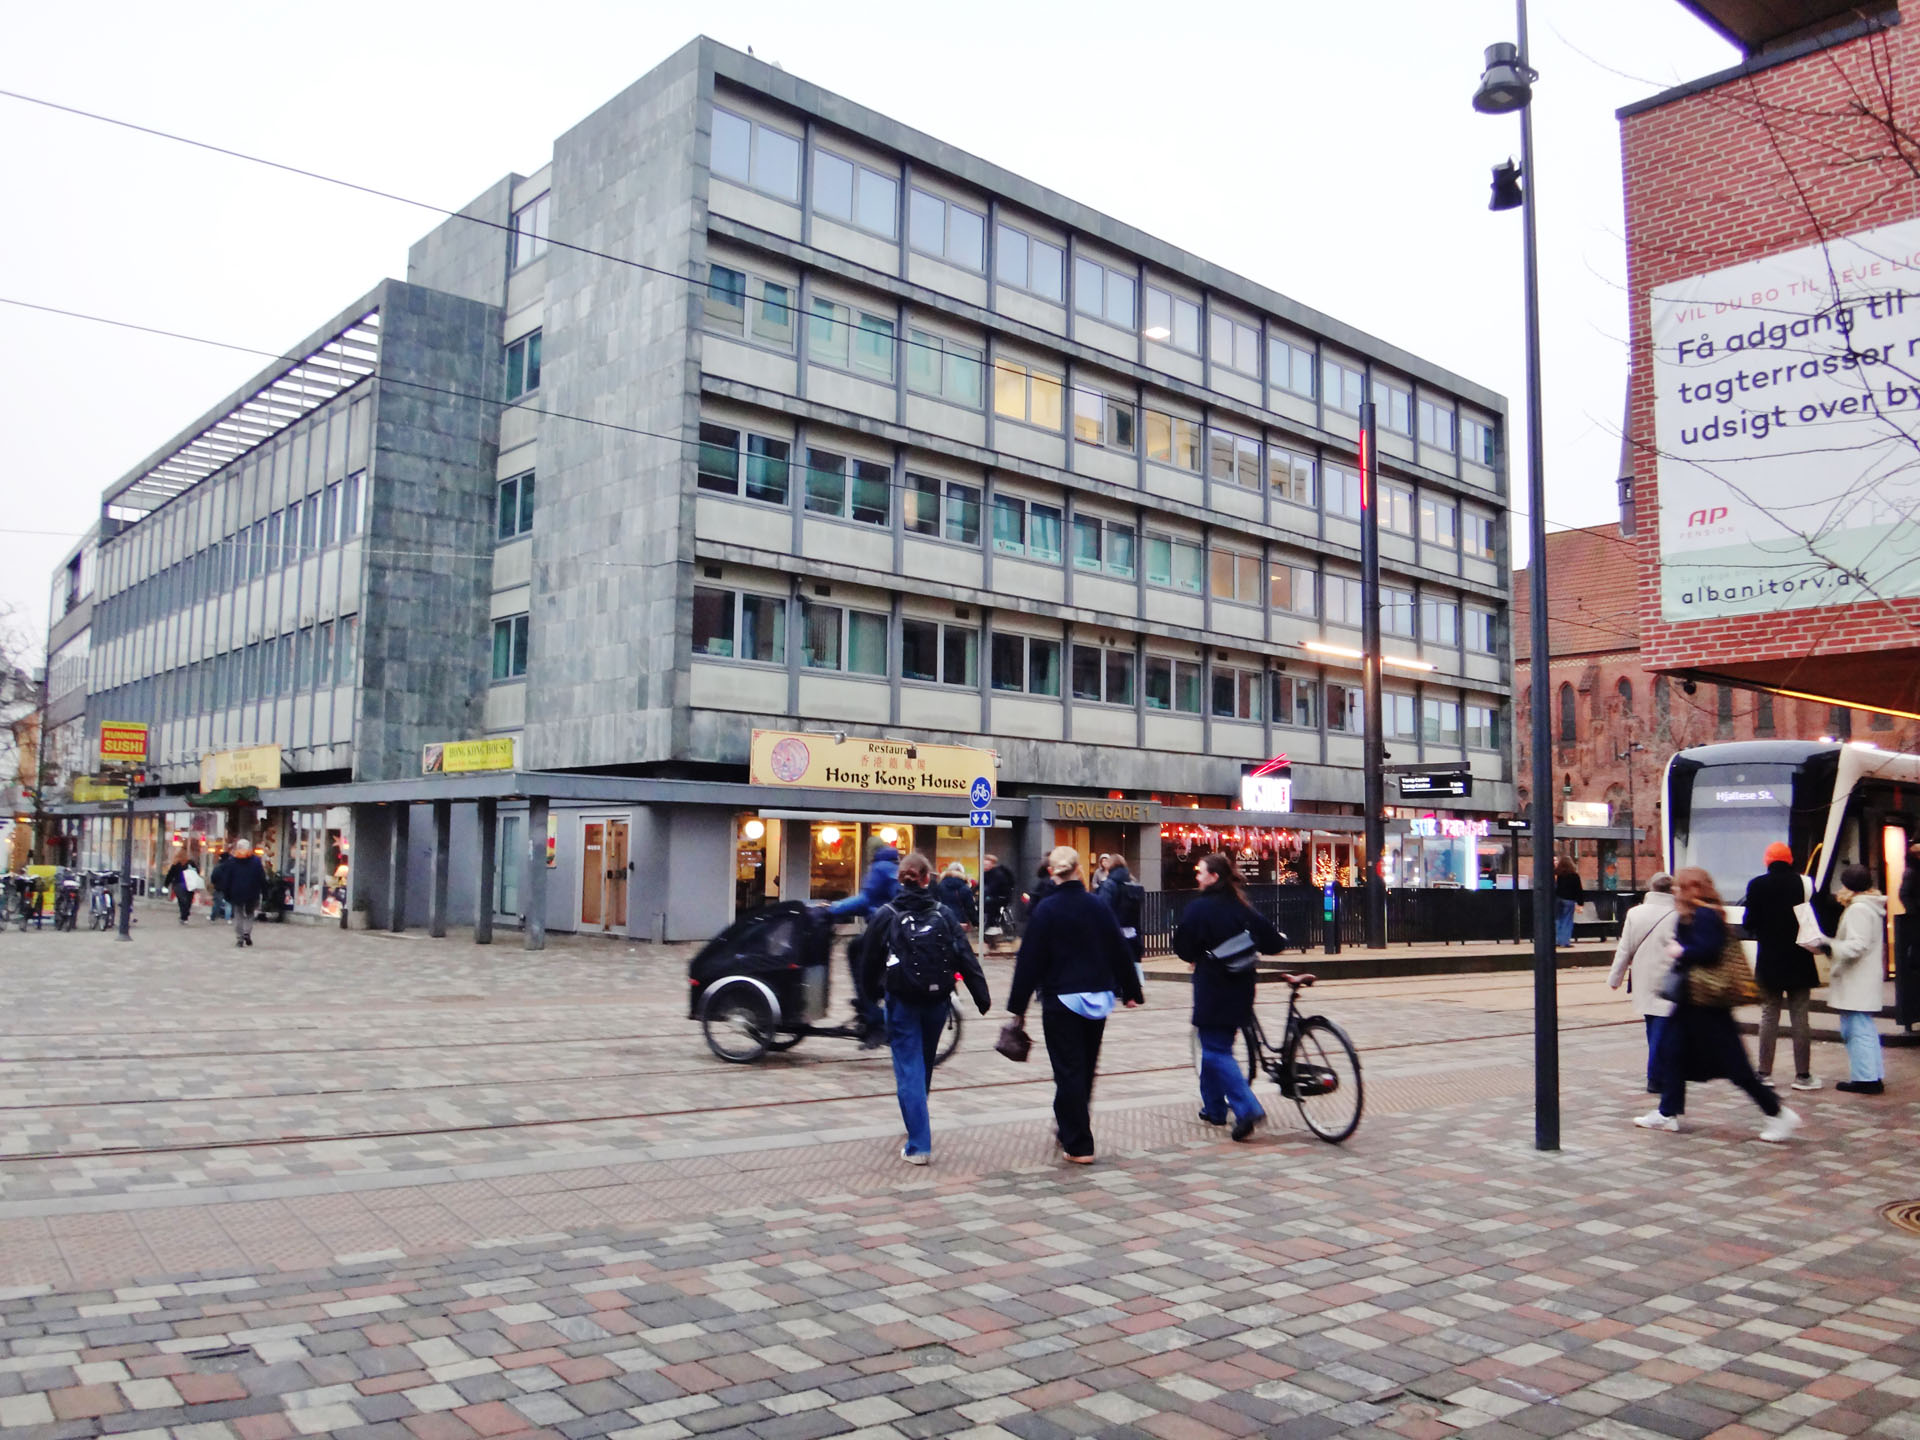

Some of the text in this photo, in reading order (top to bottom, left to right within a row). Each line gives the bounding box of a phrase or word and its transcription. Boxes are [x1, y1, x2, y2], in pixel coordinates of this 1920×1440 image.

[1675, 307, 1706, 323] VIL
[1714, 298, 1742, 314] DU
[1751, 288, 1780, 307] BO
[1788, 279, 1819, 296] TIL
[1830, 262, 1881, 286] EJE
[1678, 288, 1904, 364] Få adgang til
[1678, 343, 1895, 404] tagterrasser
[1681, 405, 1787, 445] udsigt
[1799, 393, 1874, 423] over
[1688, 506, 1728, 528] AP
[1682, 567, 1869, 604] albanitorv.dk
[104, 740, 144, 752] SUSHI
[869, 743, 916, 756] Restaura
[826, 767, 967, 790] Hong Kong House
[1715, 791, 1757, 802] Hjallese
[1056, 801, 1151, 820] TORVEGADE 1
